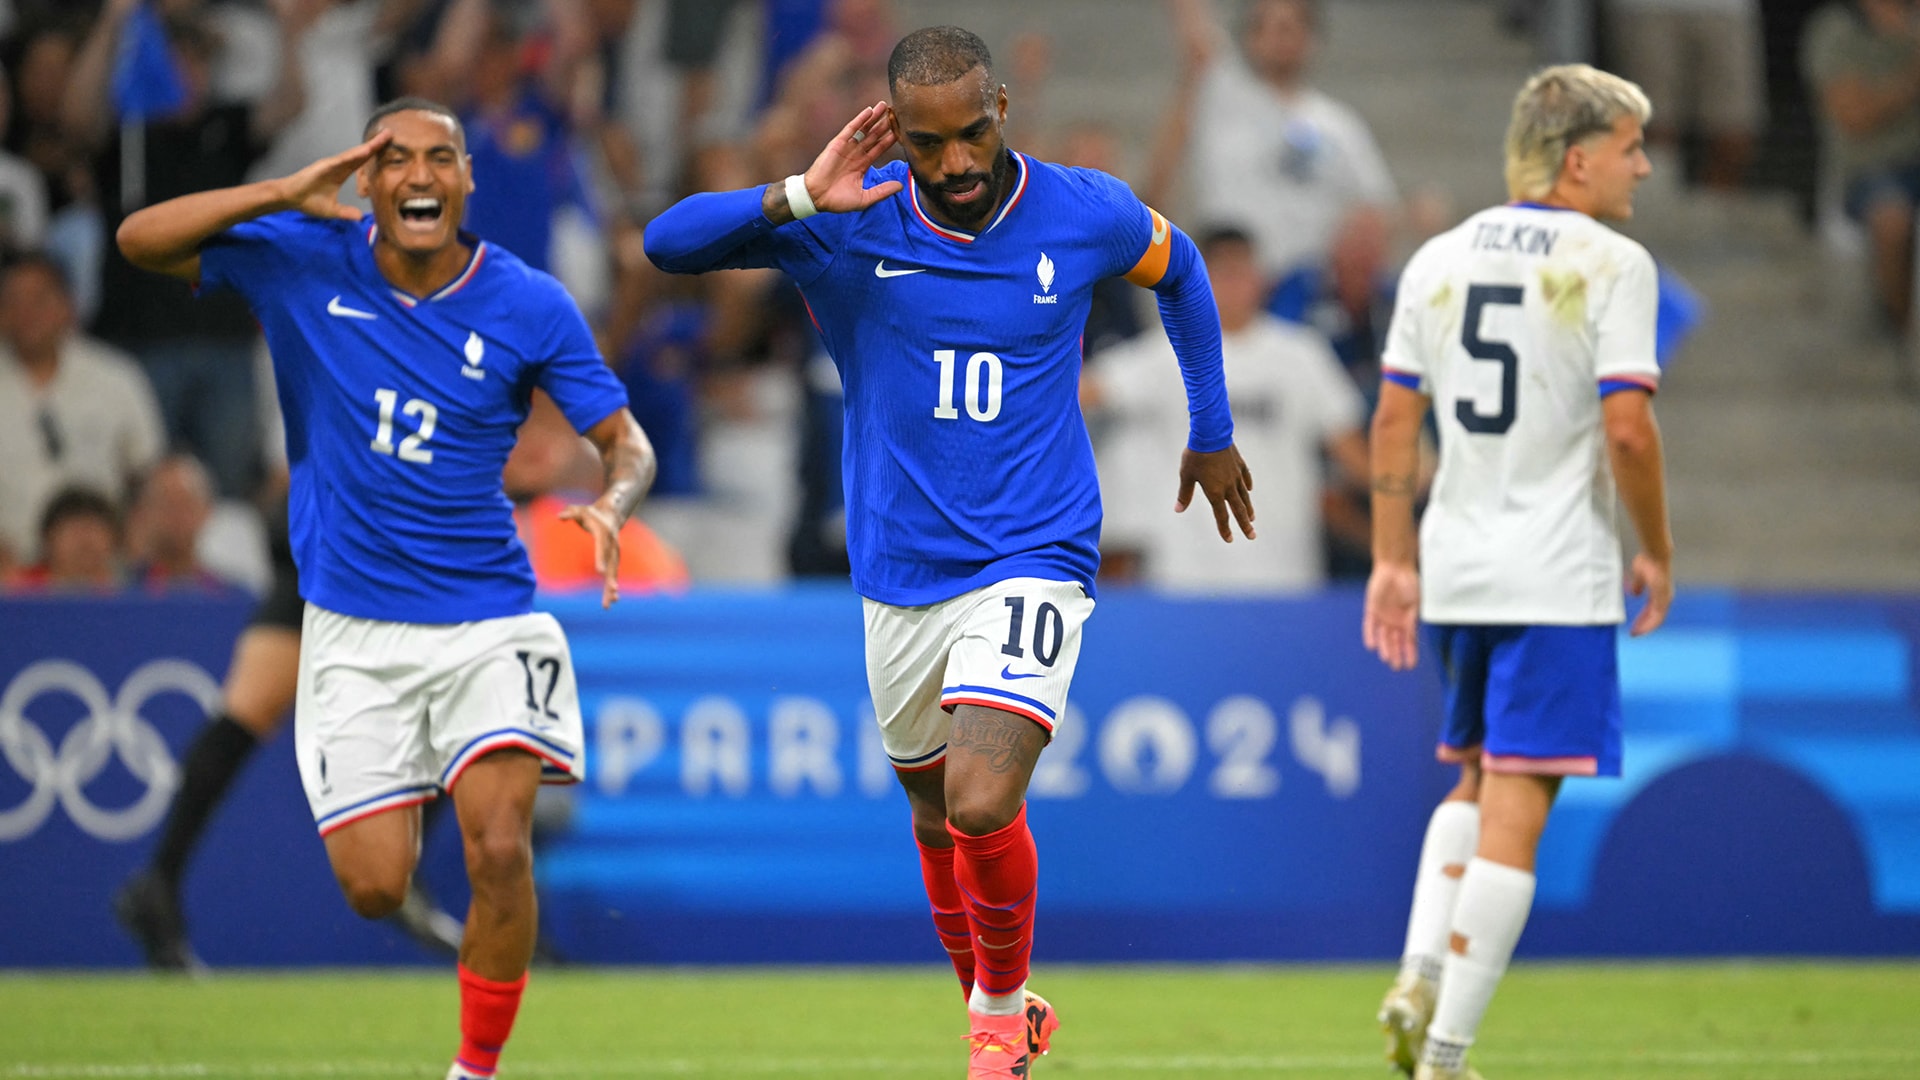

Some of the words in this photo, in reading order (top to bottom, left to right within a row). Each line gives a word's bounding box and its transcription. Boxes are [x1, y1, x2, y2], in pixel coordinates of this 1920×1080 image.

[1033, 293, 1058, 304] FRANCE
[933, 350, 1003, 422] 10
[1456, 283, 1524, 435] 5
[370, 388, 439, 464] 12
[1001, 596, 1064, 668] 10
[516, 650, 562, 721] 12
[597, 696, 893, 797] PARI
